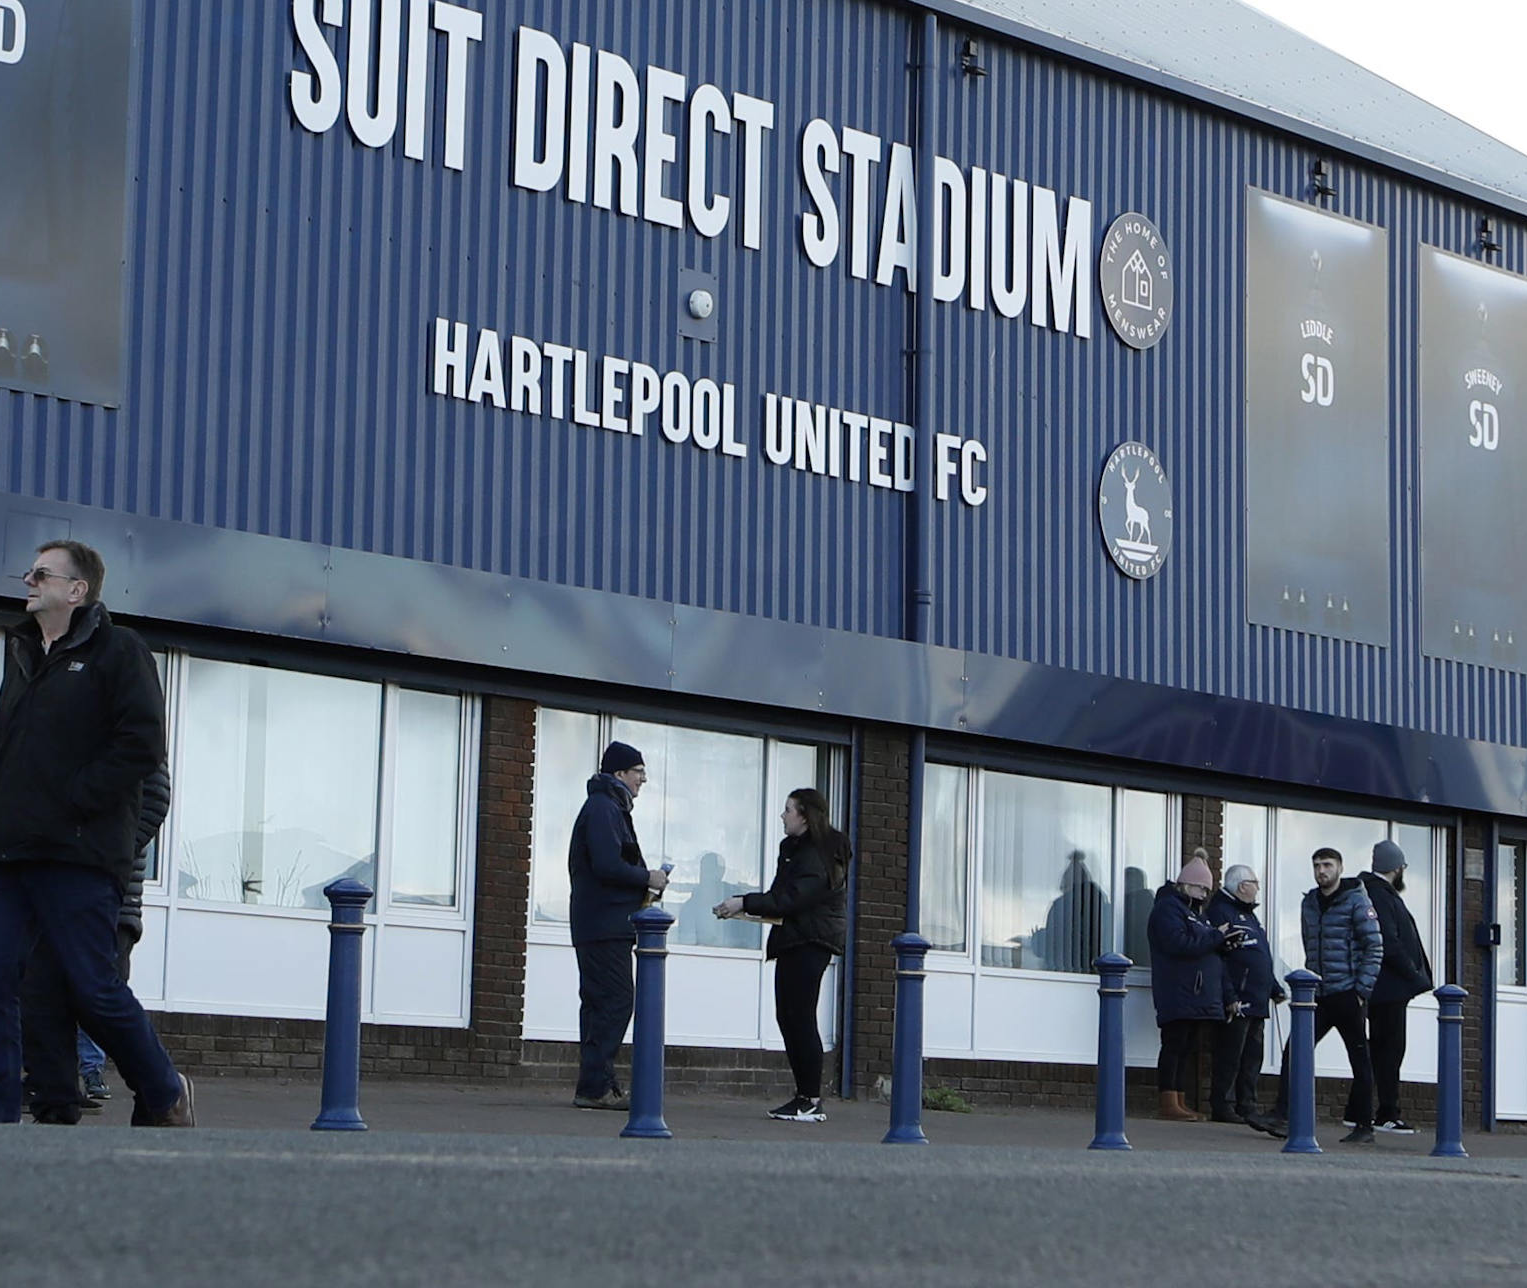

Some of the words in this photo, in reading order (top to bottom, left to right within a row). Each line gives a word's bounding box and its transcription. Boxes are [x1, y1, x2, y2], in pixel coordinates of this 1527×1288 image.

[514, 25, 774, 250] DIRECT
[802, 118, 1092, 339] STADIUM
[1106, 230, 1123, 264] THE
[1125, 222, 1158, 250] HOME
[1157, 255, 1168, 280] OF
[1108, 294, 1166, 340] MENSWEAR
[1300, 319, 1335, 345] LIDDLE
[1301, 353, 1334, 407] SD
[1464, 368, 1503, 396] SWEENEY
[434, 317, 747, 458] HARTLEPOOL
[765, 392, 915, 492] UNITED
[936, 433, 987, 506] FC
[1469, 400, 1499, 451] SD
[1108, 445, 1164, 484] HARTLEPOOL
[1112, 546, 1147, 576] UNITED
[1150, 553, 1162, 570] FC
